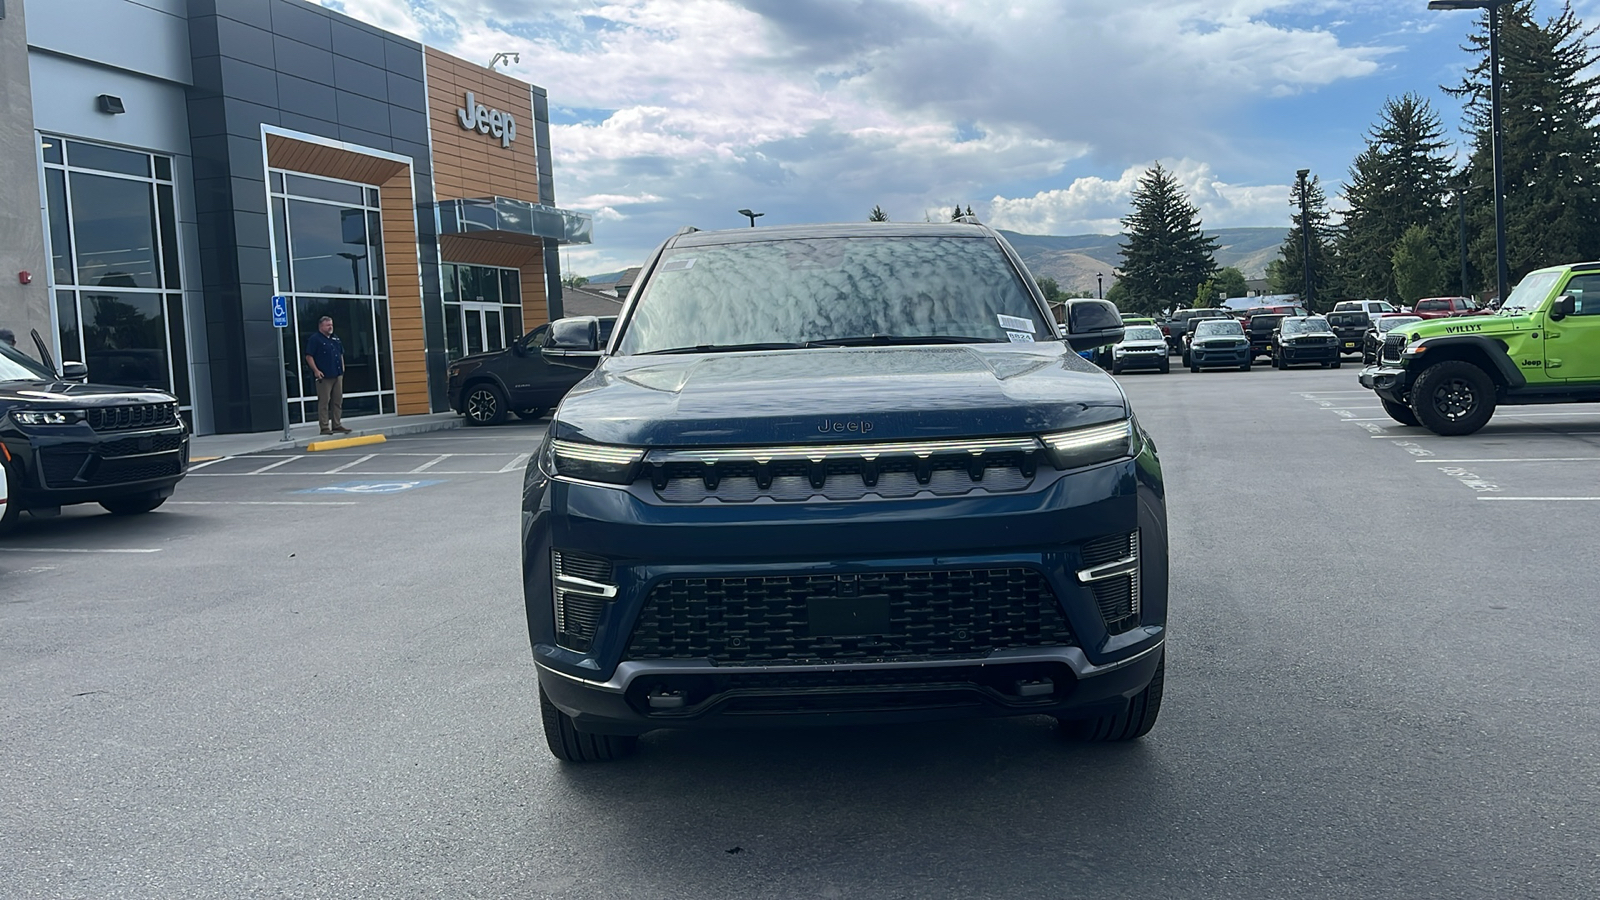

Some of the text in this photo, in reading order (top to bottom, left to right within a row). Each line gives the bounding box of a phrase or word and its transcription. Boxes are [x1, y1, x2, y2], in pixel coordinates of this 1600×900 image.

[457, 91, 516, 148] Jeep
[1445, 324, 1482, 333] WILLYS
[1521, 359, 1542, 367] Jeep
[817, 419, 874, 434] Jeep
